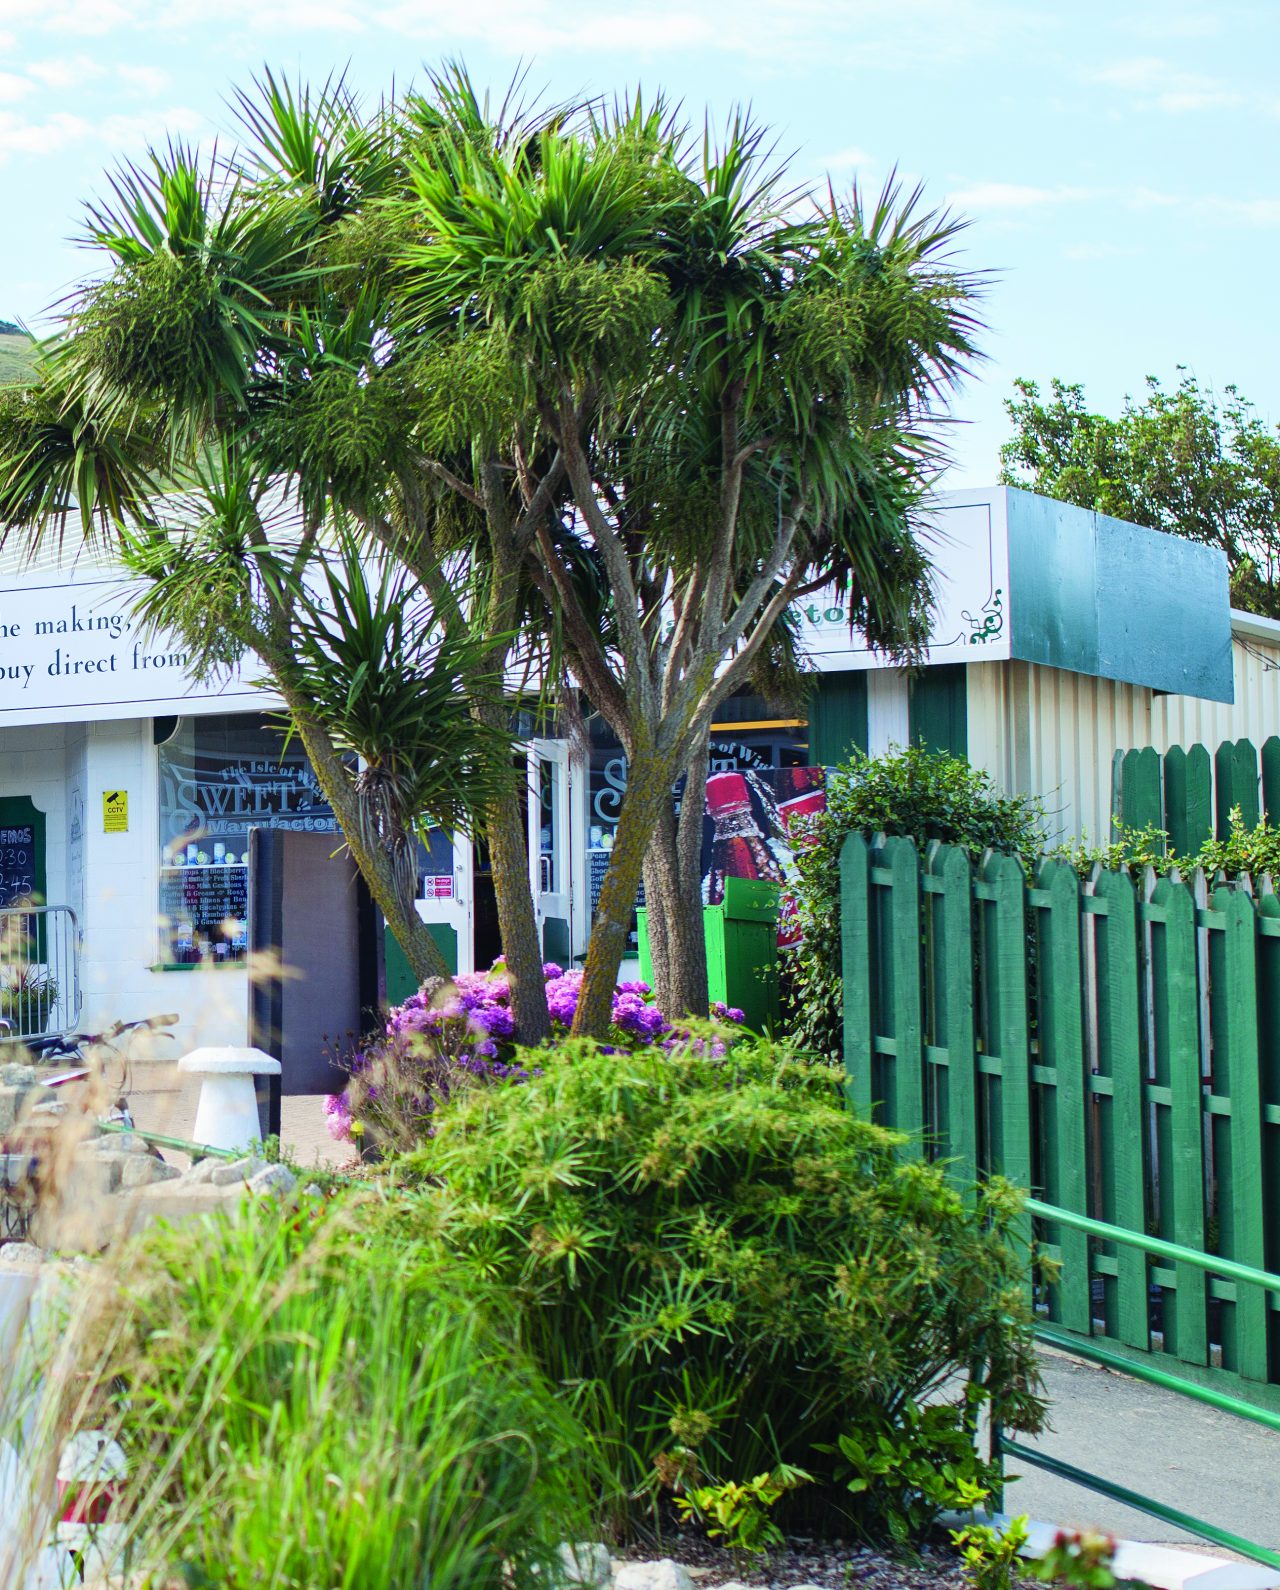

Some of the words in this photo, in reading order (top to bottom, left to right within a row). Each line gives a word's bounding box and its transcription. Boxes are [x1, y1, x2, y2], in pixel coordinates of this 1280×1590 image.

[35, 605, 132, 639] making,
[47, 649, 118, 676] direct
[132, 642, 188, 670] from
[250, 761, 277, 774] Isle
[279, 765, 295, 777] of
[207, 816, 338, 834] Manufactor
